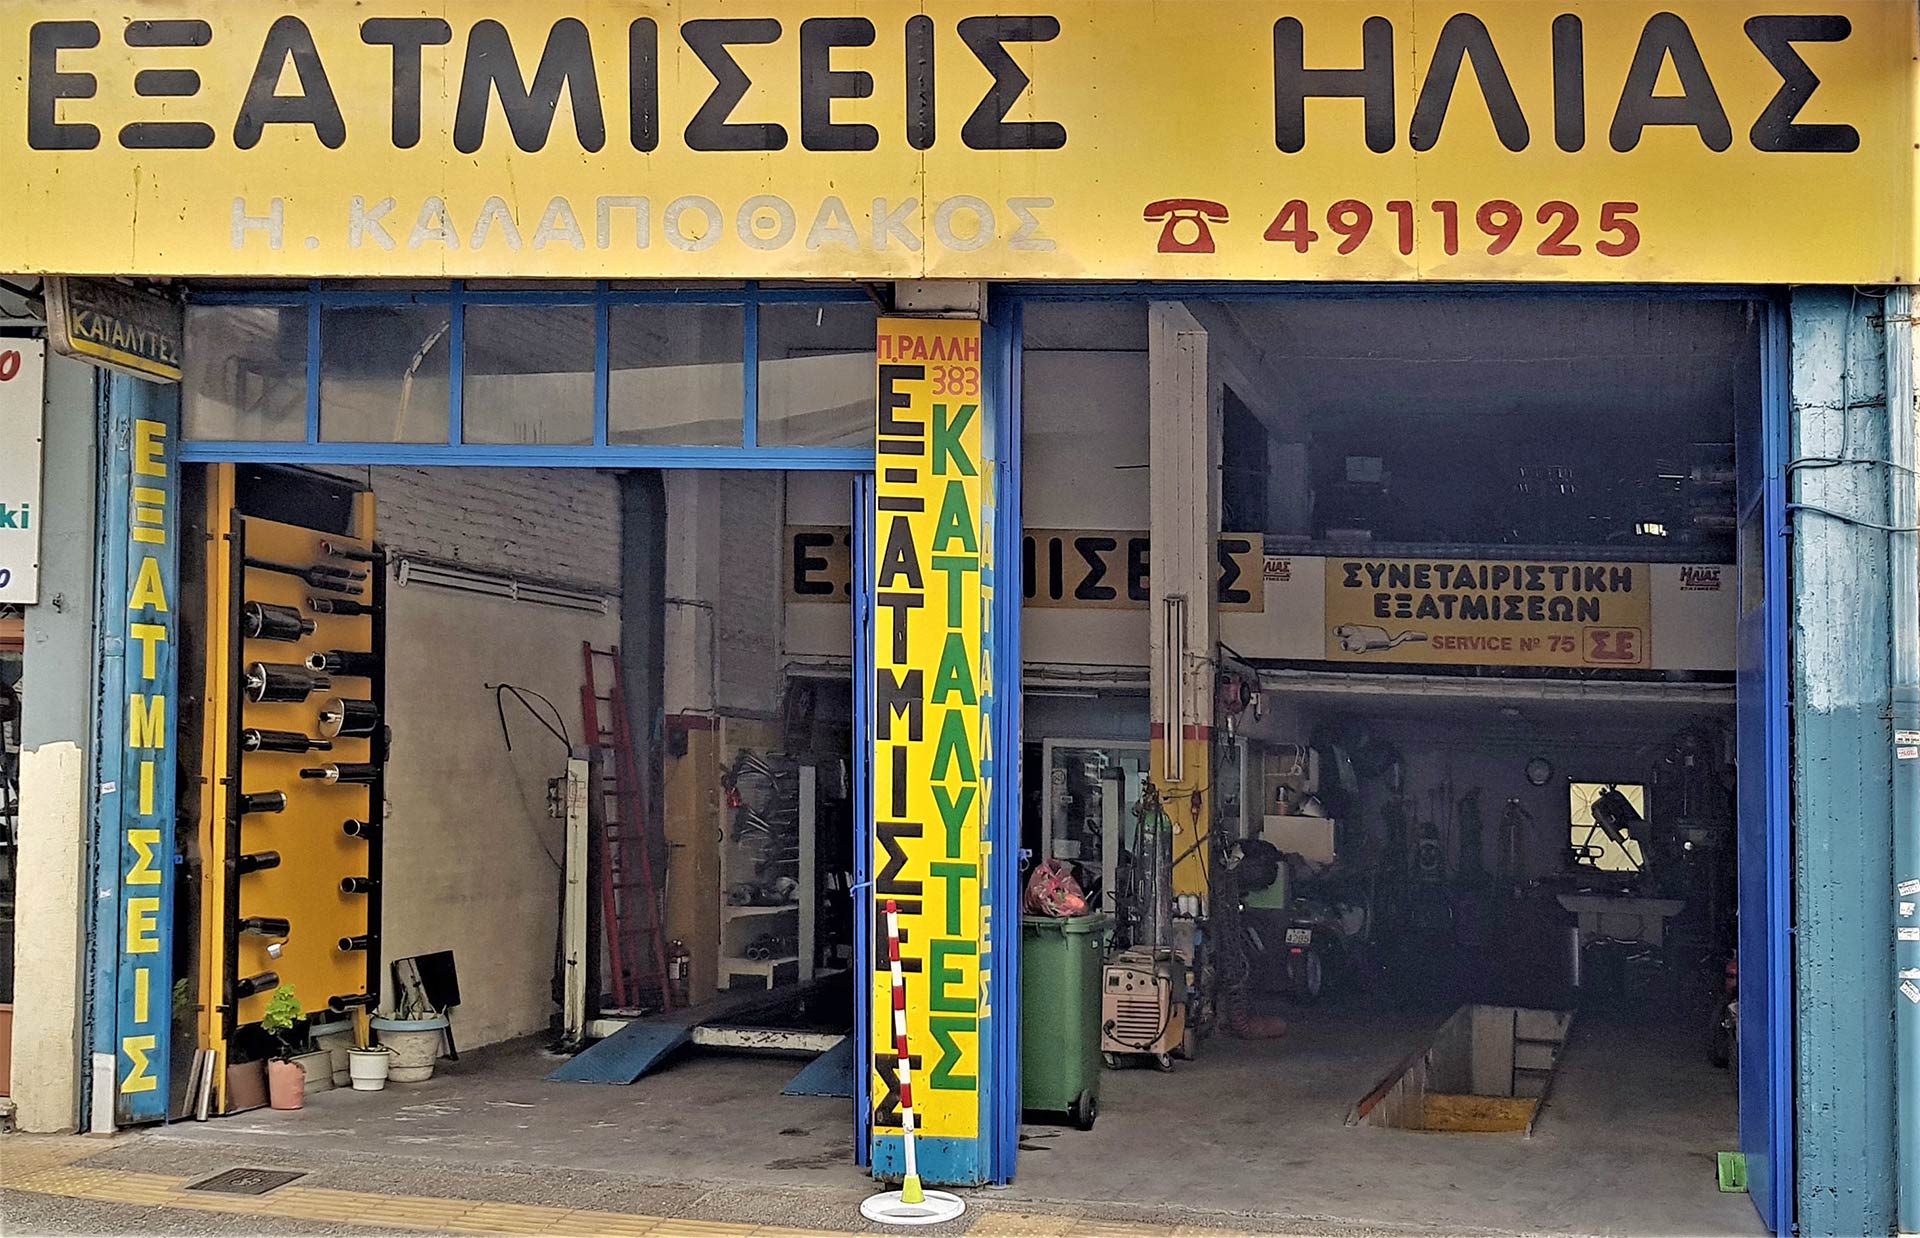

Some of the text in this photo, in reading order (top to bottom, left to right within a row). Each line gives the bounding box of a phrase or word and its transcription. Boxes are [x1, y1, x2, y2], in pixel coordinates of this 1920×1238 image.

[28, 12, 1860, 154] ΕΞΑΤΜΙΣΕΙΣ ΗΛΙΑΣ
[349, 194, 1057, 252] ΚΑΛΑΠΟΘΑΚΟΣ
[1263, 199, 1641, 256] 4911925
[72, 307, 178, 364] ΚΑΤΑΛΥΤΕΣ
[877, 335, 979, 363] Π.ΡΑΛΛΗ
[932, 366, 979, 397] 383
[1342, 562, 1632, 593] ΣΥΝΕΤΑΙΡΙΣΤΙΚΗ
[1374, 592, 1601, 622] ΕΞΑΤΜΙΣΕΩΝ
[1432, 635, 1512, 651] SERVICE
[1547, 634, 1575, 652] 75
[121, 419, 168, 1094] ΕΞΑΤΜΙΣΕΙΣ
[930, 404, 979, 1090] ΚΑΤΑΛΥΤΕΣ
